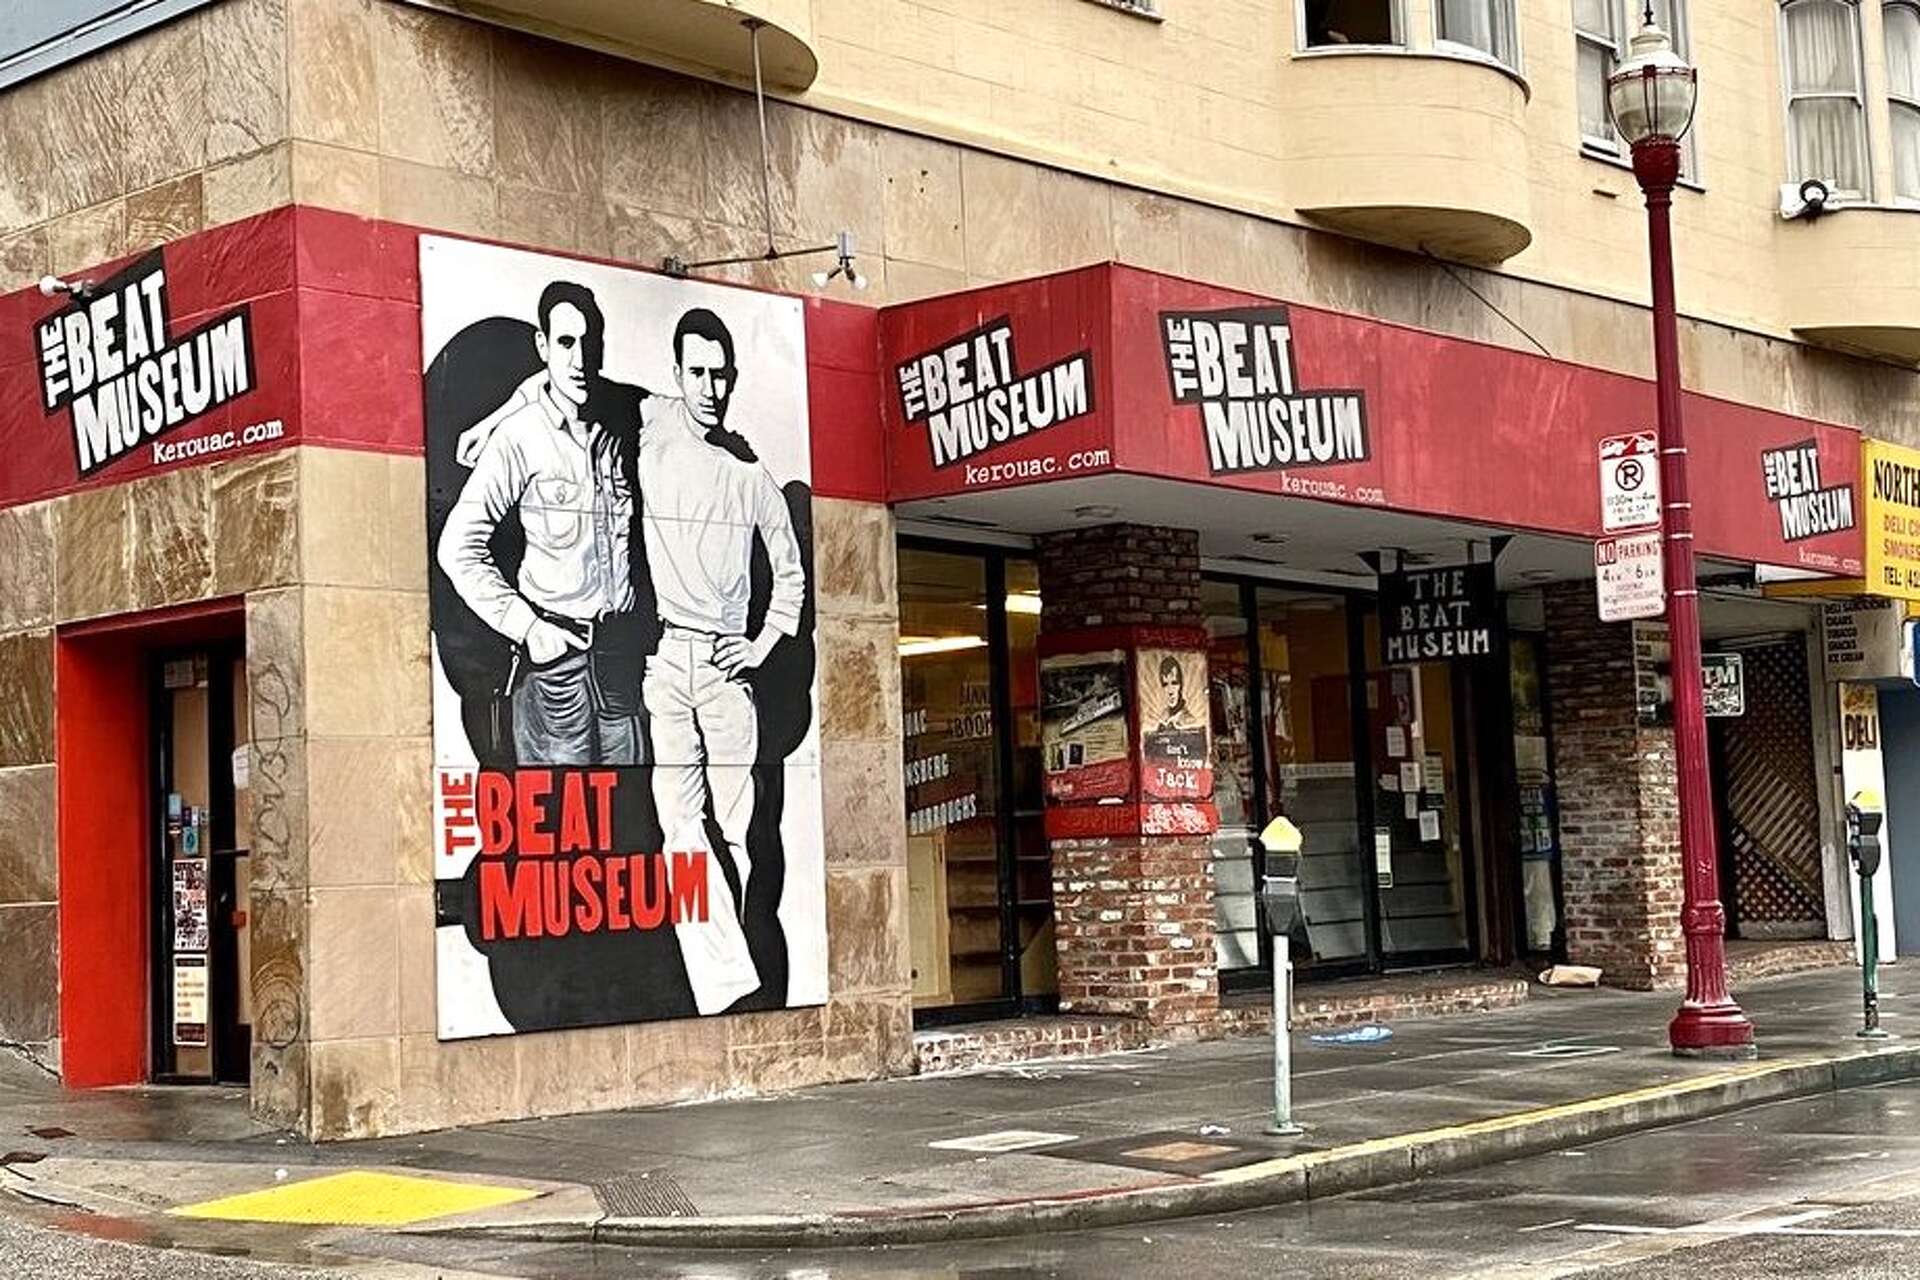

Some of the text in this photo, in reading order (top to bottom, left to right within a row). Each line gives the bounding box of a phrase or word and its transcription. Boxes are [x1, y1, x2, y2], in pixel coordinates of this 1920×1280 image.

[64, 269, 167, 394] BEAT
[41, 316, 70, 407] THE
[924, 327, 1012, 412] BEAT
[1168, 318, 1198, 398] THE
[1193, 320, 1294, 397] BEAT
[73, 316, 249, 470] MUSEUM
[900, 359, 925, 420] THE
[929, 359, 1088, 466] MUSEUM
[152, 419, 283, 464] kerouac.com
[1202, 397, 1365, 469] MUSEUM
[965, 448, 1110, 485] kerouac.com
[1281, 473, 1385, 502] kerouac.com
[1763, 453, 1778, 498] THE
[1775, 448, 1819, 497] BEAT
[1873, 459, 1920, 508] NORTH
[1780, 488, 1853, 540] MUSEUM
[1884, 514, 1906, 534] DELI
[1599, 543, 1614, 565] NO
[1408, 570, 1464, 599] THE
[1401, 601, 1470, 630] BEAT
[1388, 629, 1490, 661] MUSEUM
[1701, 666, 1736, 685] TM
[1845, 714, 1877, 750] DELI
[1156, 768, 1198, 789] Jack
[441, 772, 476, 856] THE
[478, 769, 618, 855] BEAT
[480, 851, 709, 940] MUSEUM
